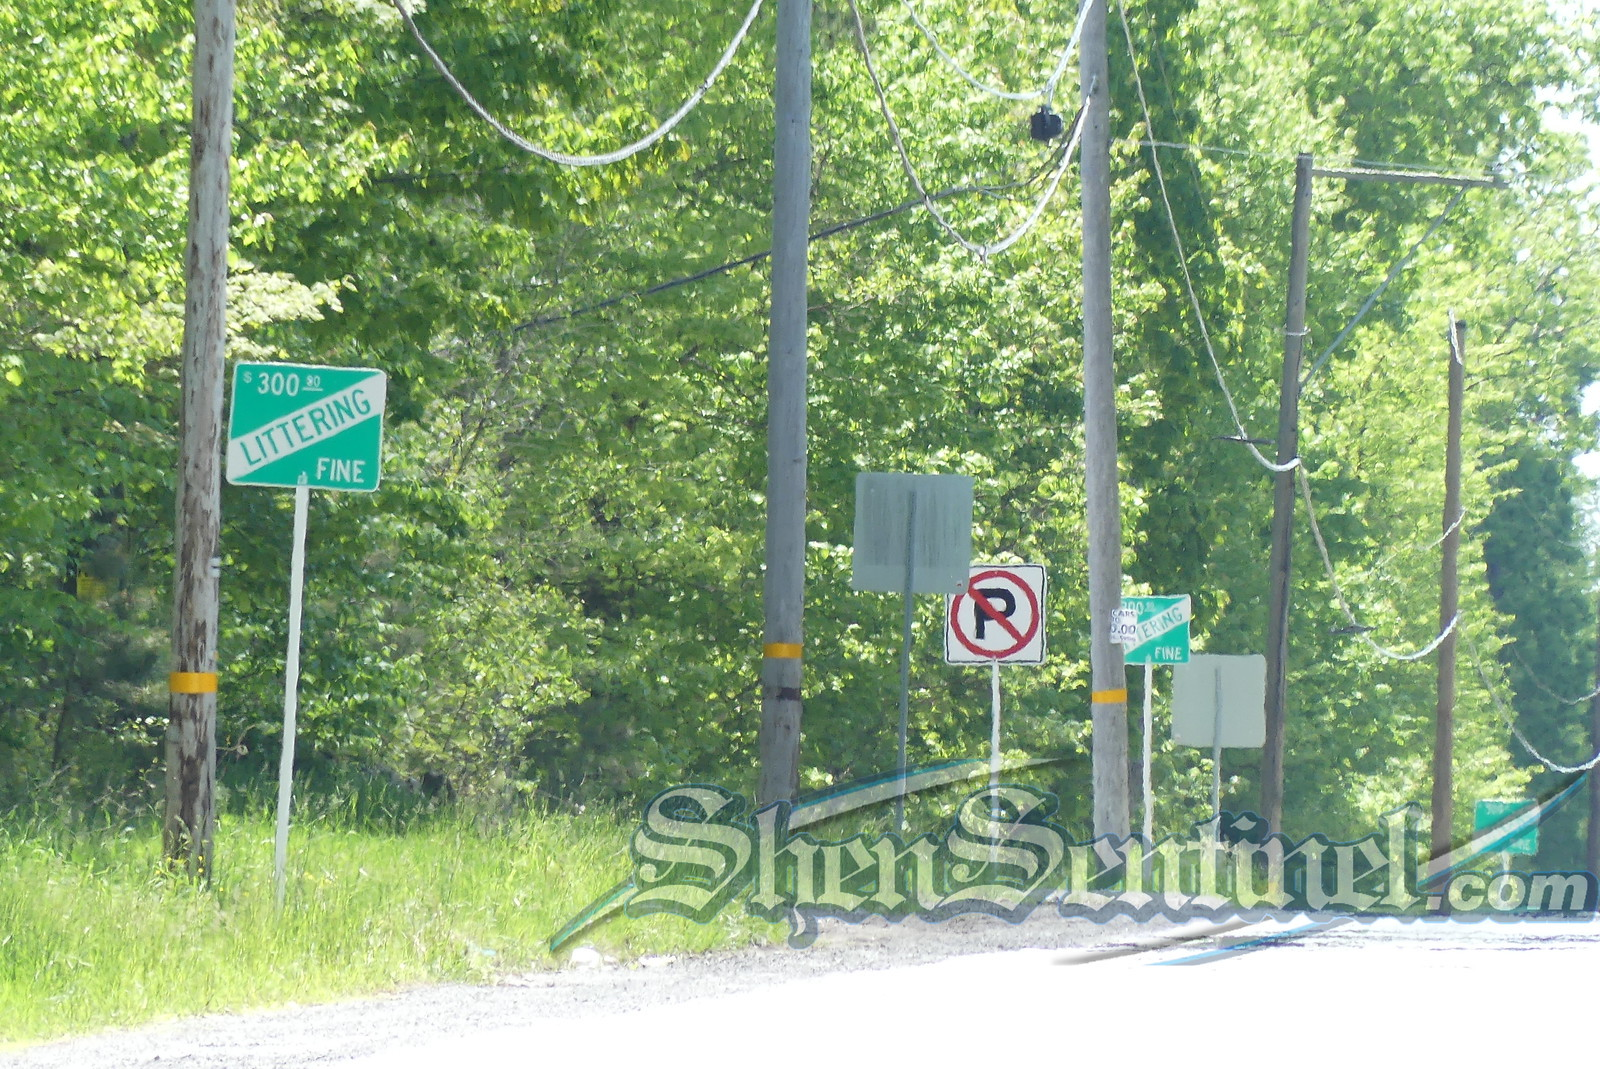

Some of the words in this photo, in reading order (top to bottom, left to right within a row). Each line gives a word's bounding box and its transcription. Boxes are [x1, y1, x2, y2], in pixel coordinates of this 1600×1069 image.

[258, 372, 300, 397] 300
[240, 389, 371, 466] LITTERING
[316, 457, 366, 483] FINE
[974, 588, 1016, 640] P
[1136, 607, 1183, 641] ERING
[1154, 647, 1182, 661] FINE
